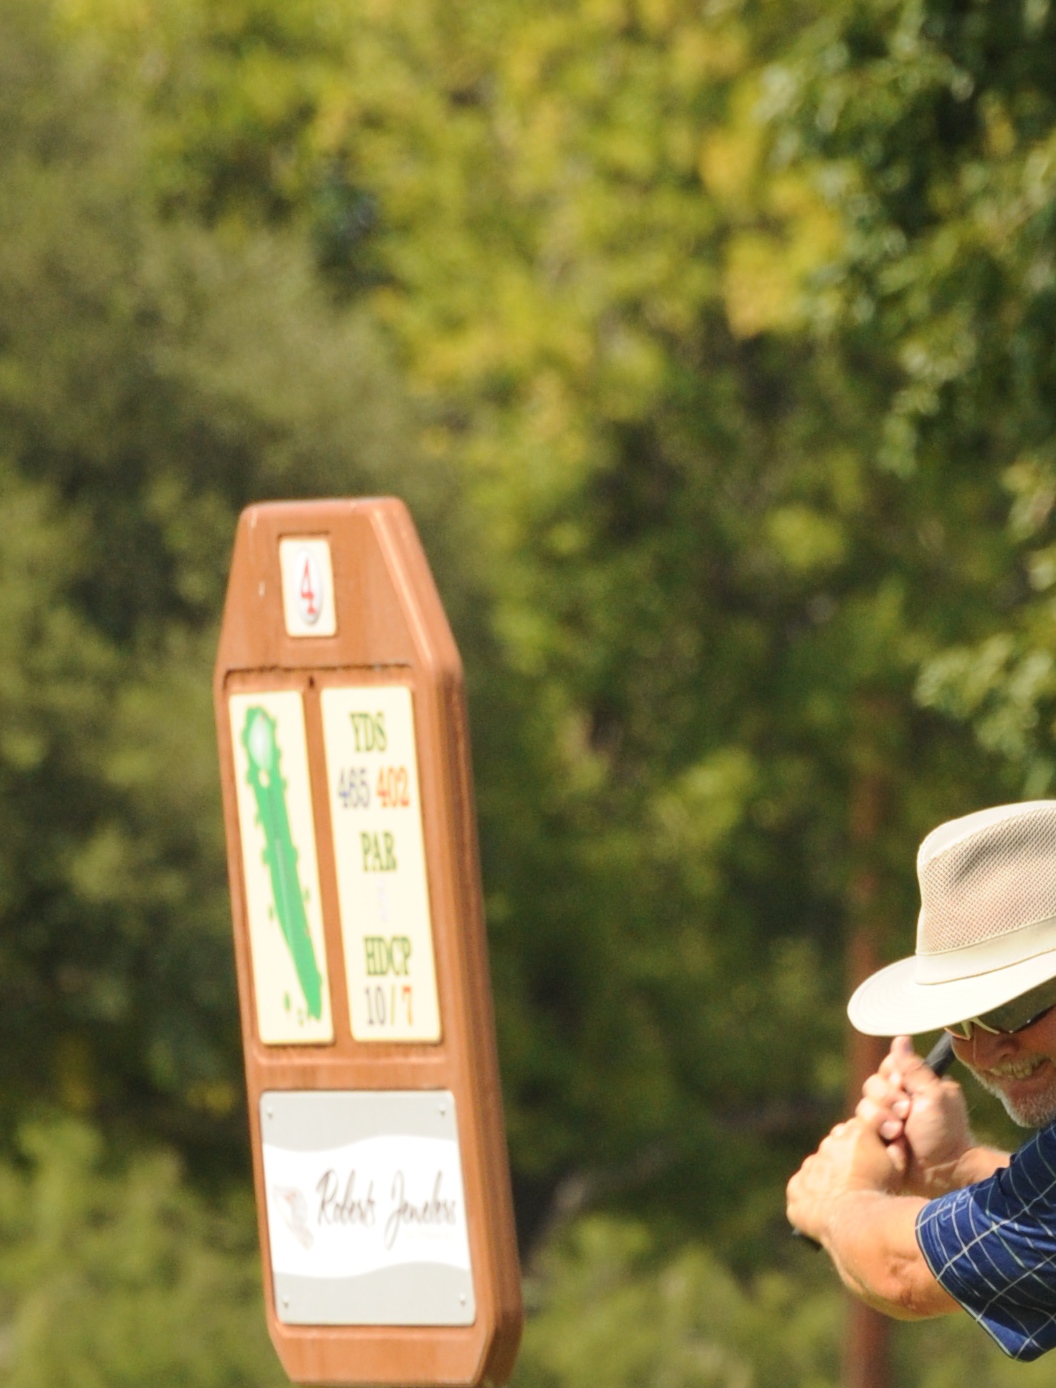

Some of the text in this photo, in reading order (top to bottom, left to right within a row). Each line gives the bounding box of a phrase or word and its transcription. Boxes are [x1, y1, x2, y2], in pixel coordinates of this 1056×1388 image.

[300, 559, 317, 616] 4
[349, 711, 388, 752] YDS
[376, 765, 410, 809] 402
[359, 831, 397, 872] PAR
[363, 935, 413, 976] HDCP
